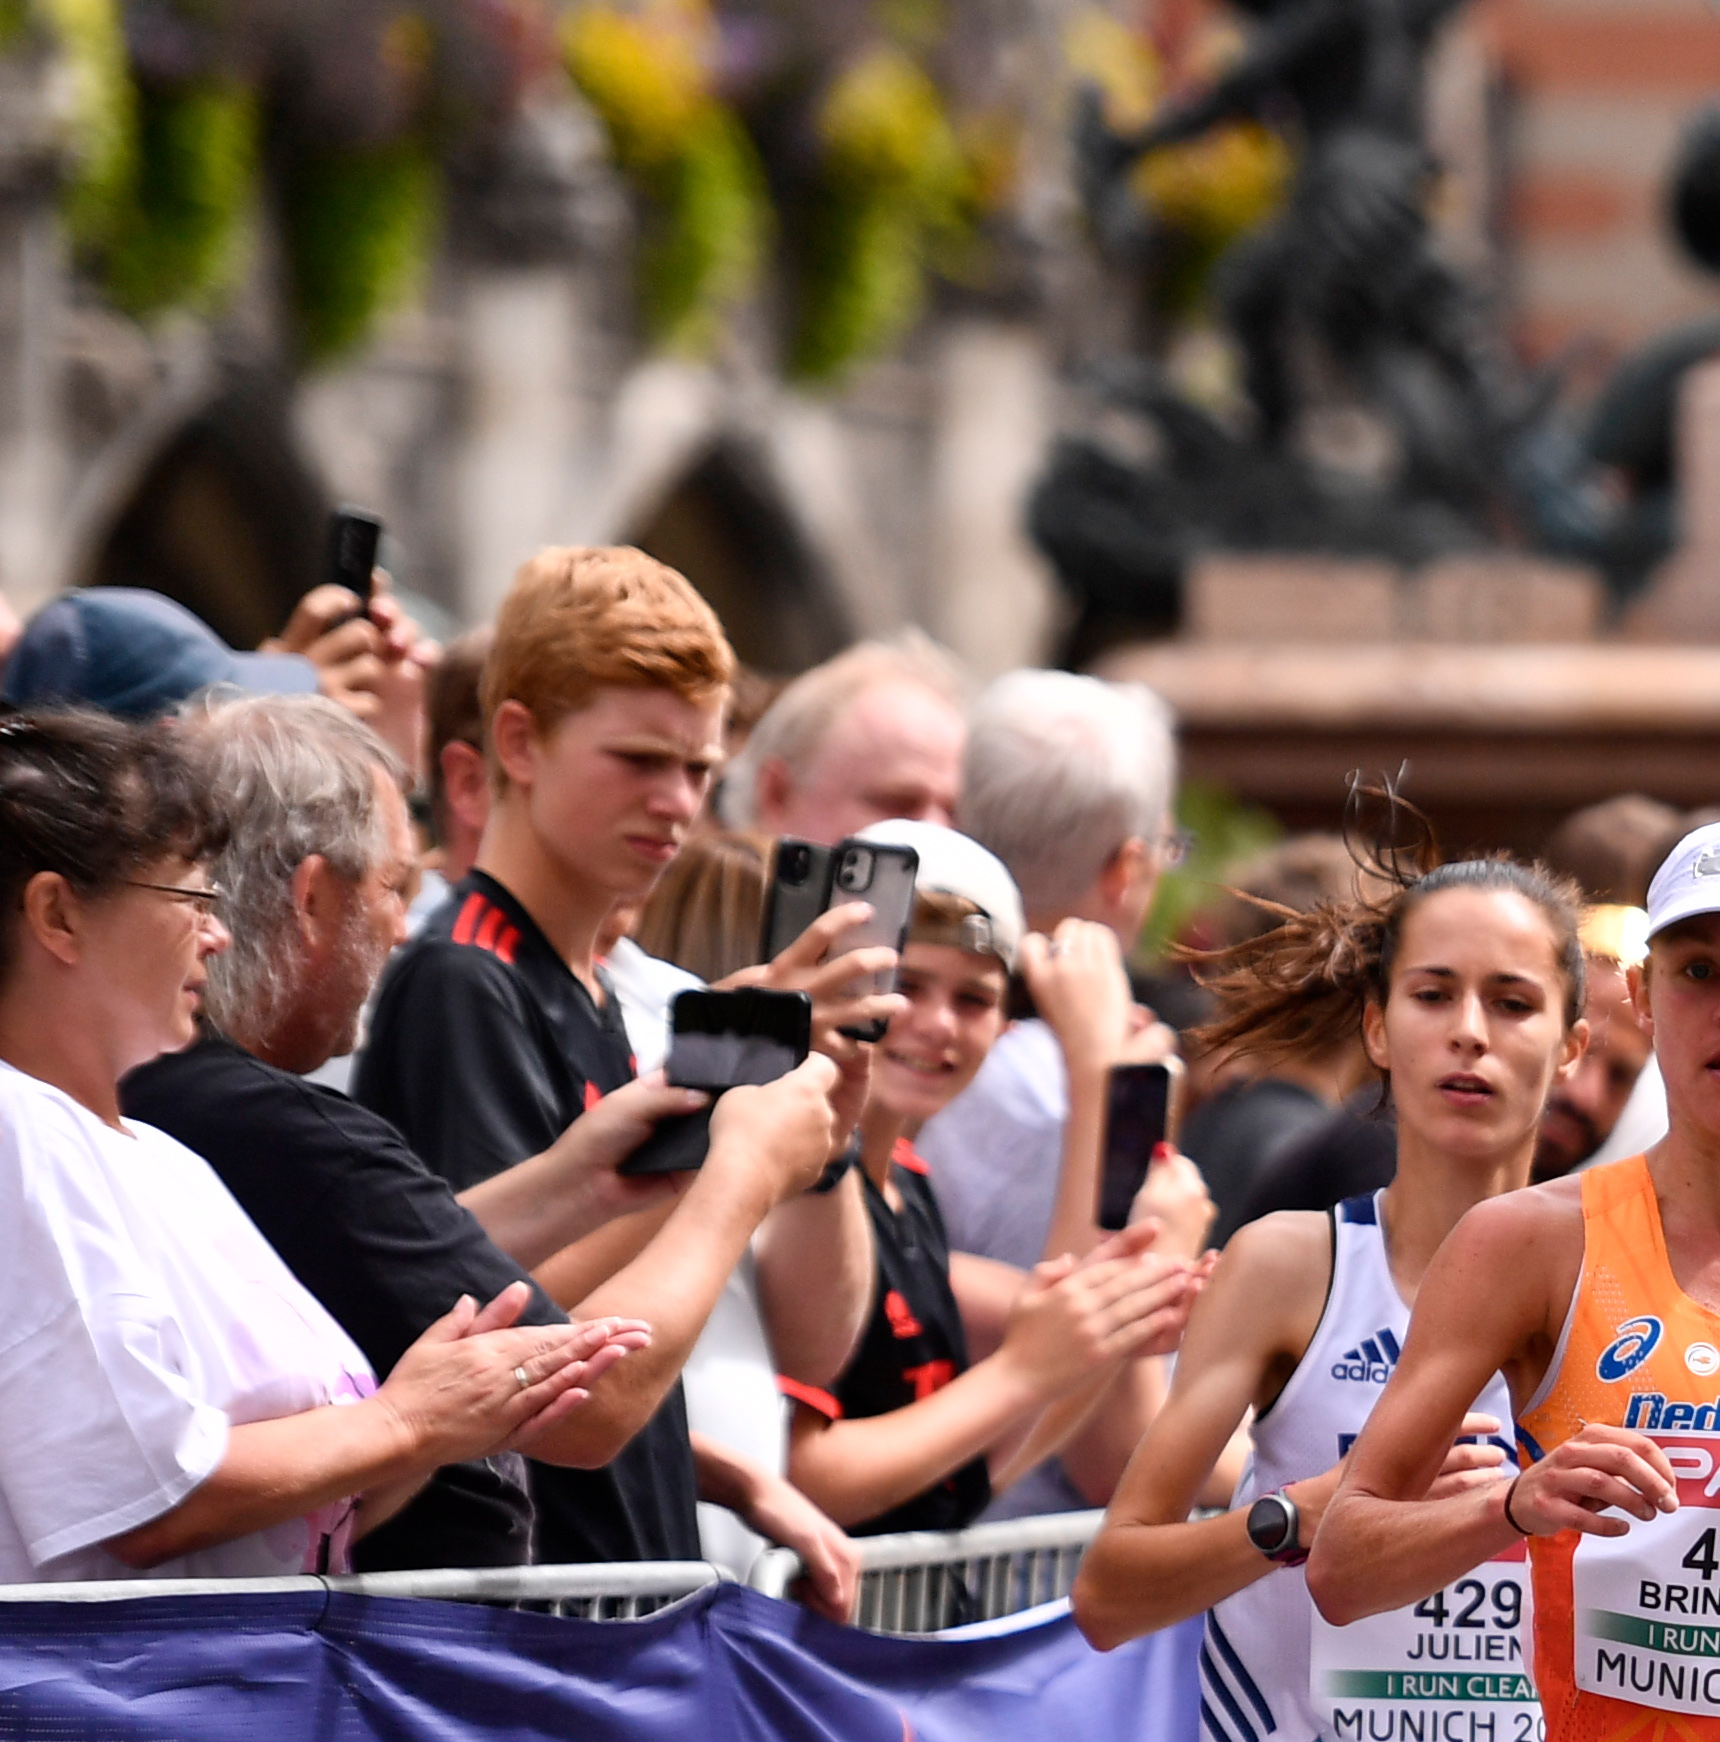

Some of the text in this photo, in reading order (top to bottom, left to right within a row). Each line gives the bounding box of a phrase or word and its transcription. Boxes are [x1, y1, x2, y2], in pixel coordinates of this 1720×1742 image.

[1413, 1579, 1522, 1630] 429
[1649, 1625, 1654, 1646] I
[1663, 1628, 1720, 1653] RUN
[1387, 1674, 1538, 1699] I RUN CLEA
